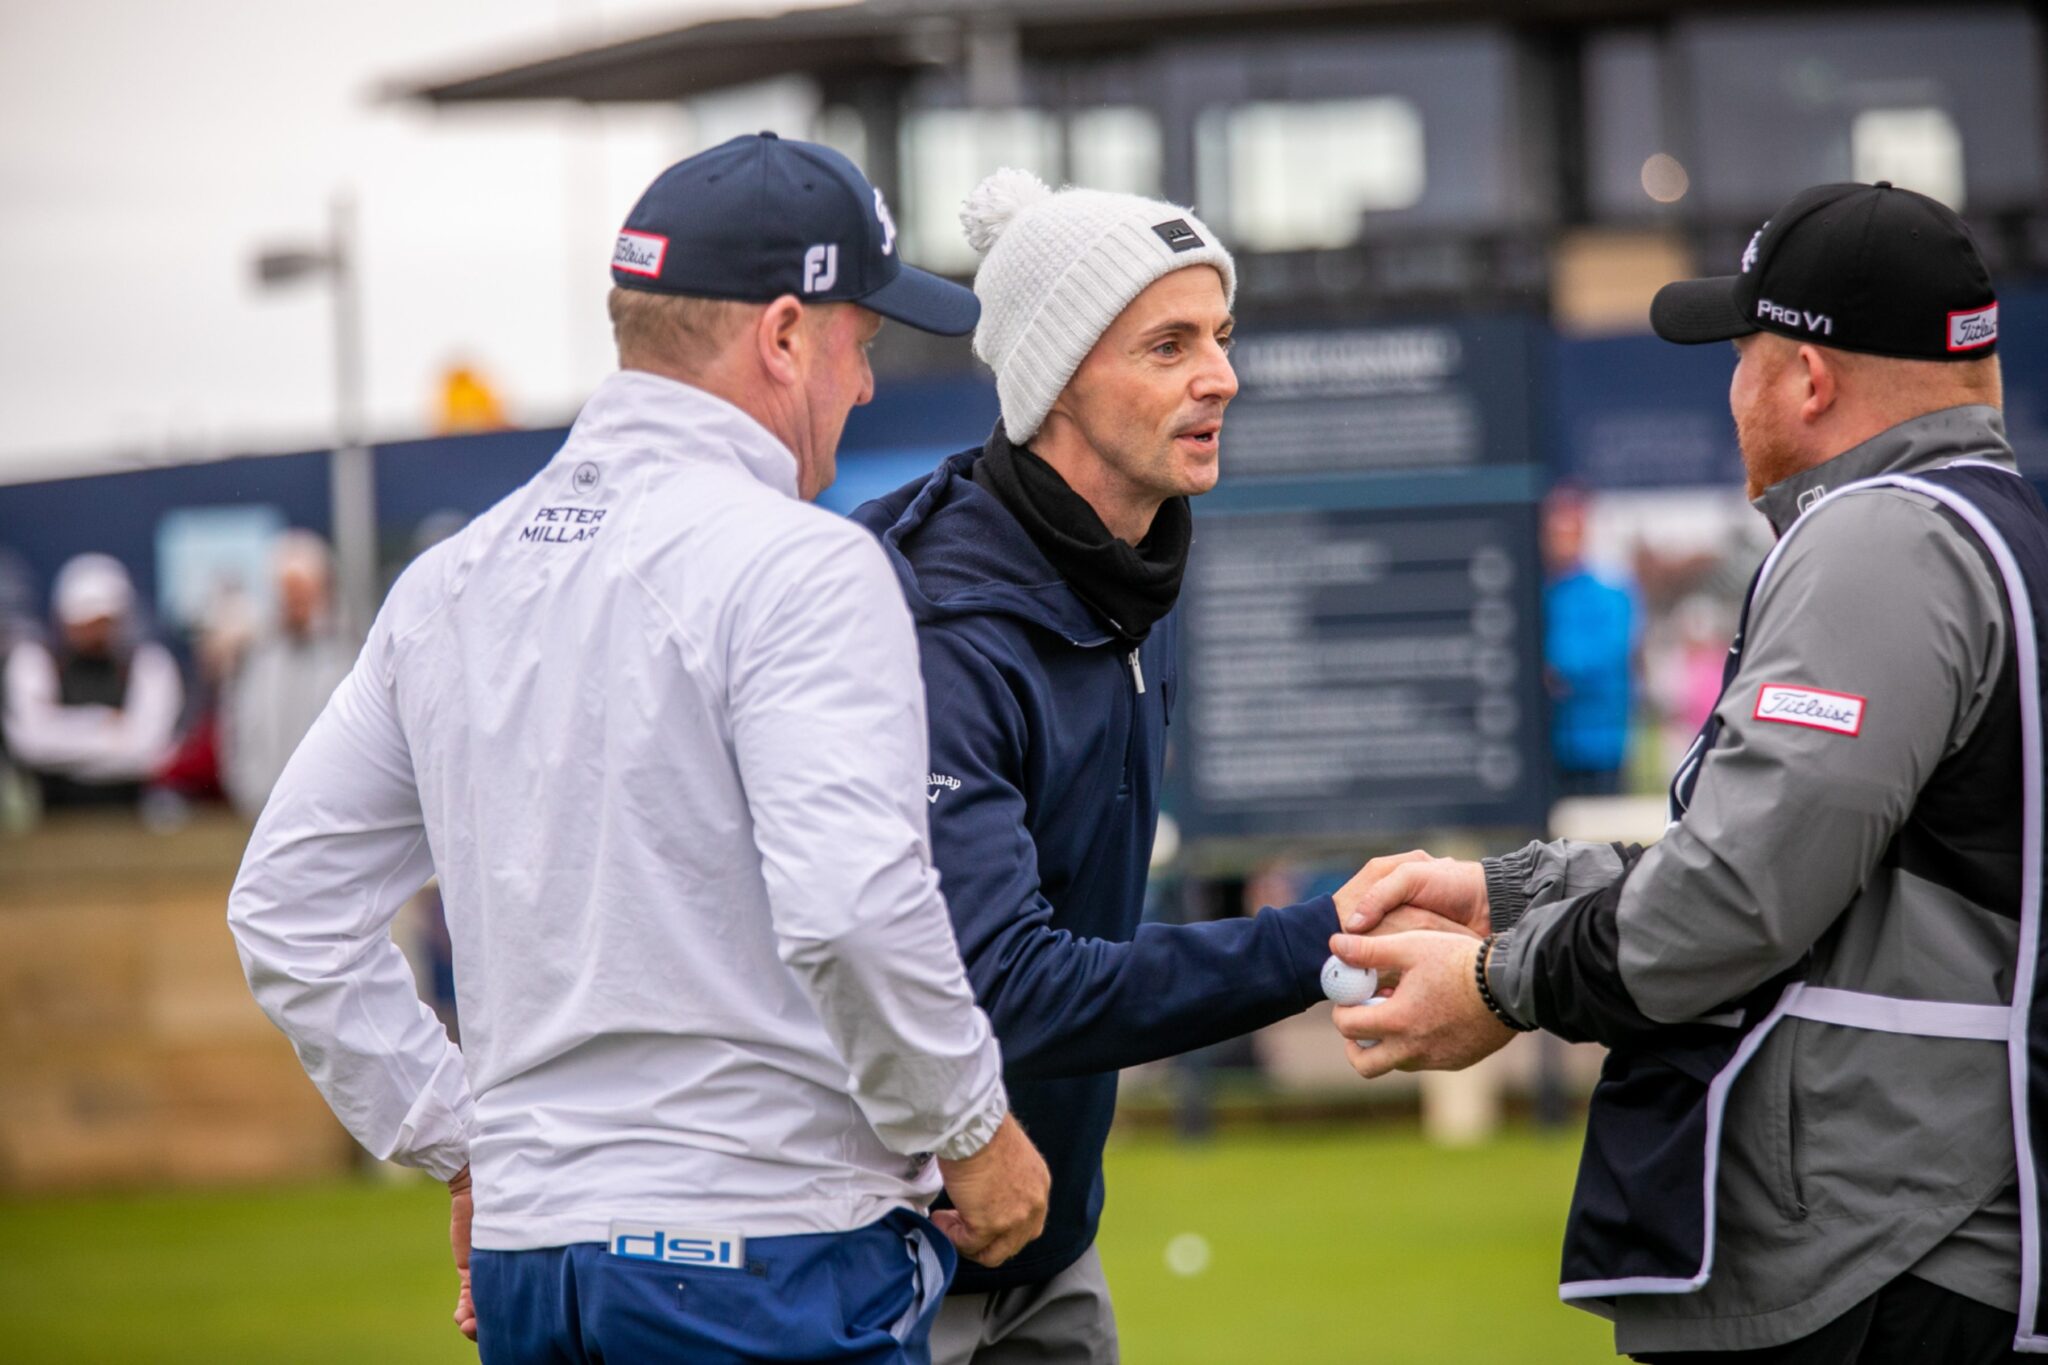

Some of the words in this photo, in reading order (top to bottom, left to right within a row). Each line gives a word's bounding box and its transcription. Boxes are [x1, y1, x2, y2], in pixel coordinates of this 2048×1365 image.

[803, 244, 838, 293] FJ
[1802, 310, 1833, 336] V1
[534, 506, 608, 524] PETER
[518, 526, 600, 543] MILLAR
[1761, 691, 1856, 724] Titleist
[926, 772, 961, 791] away
